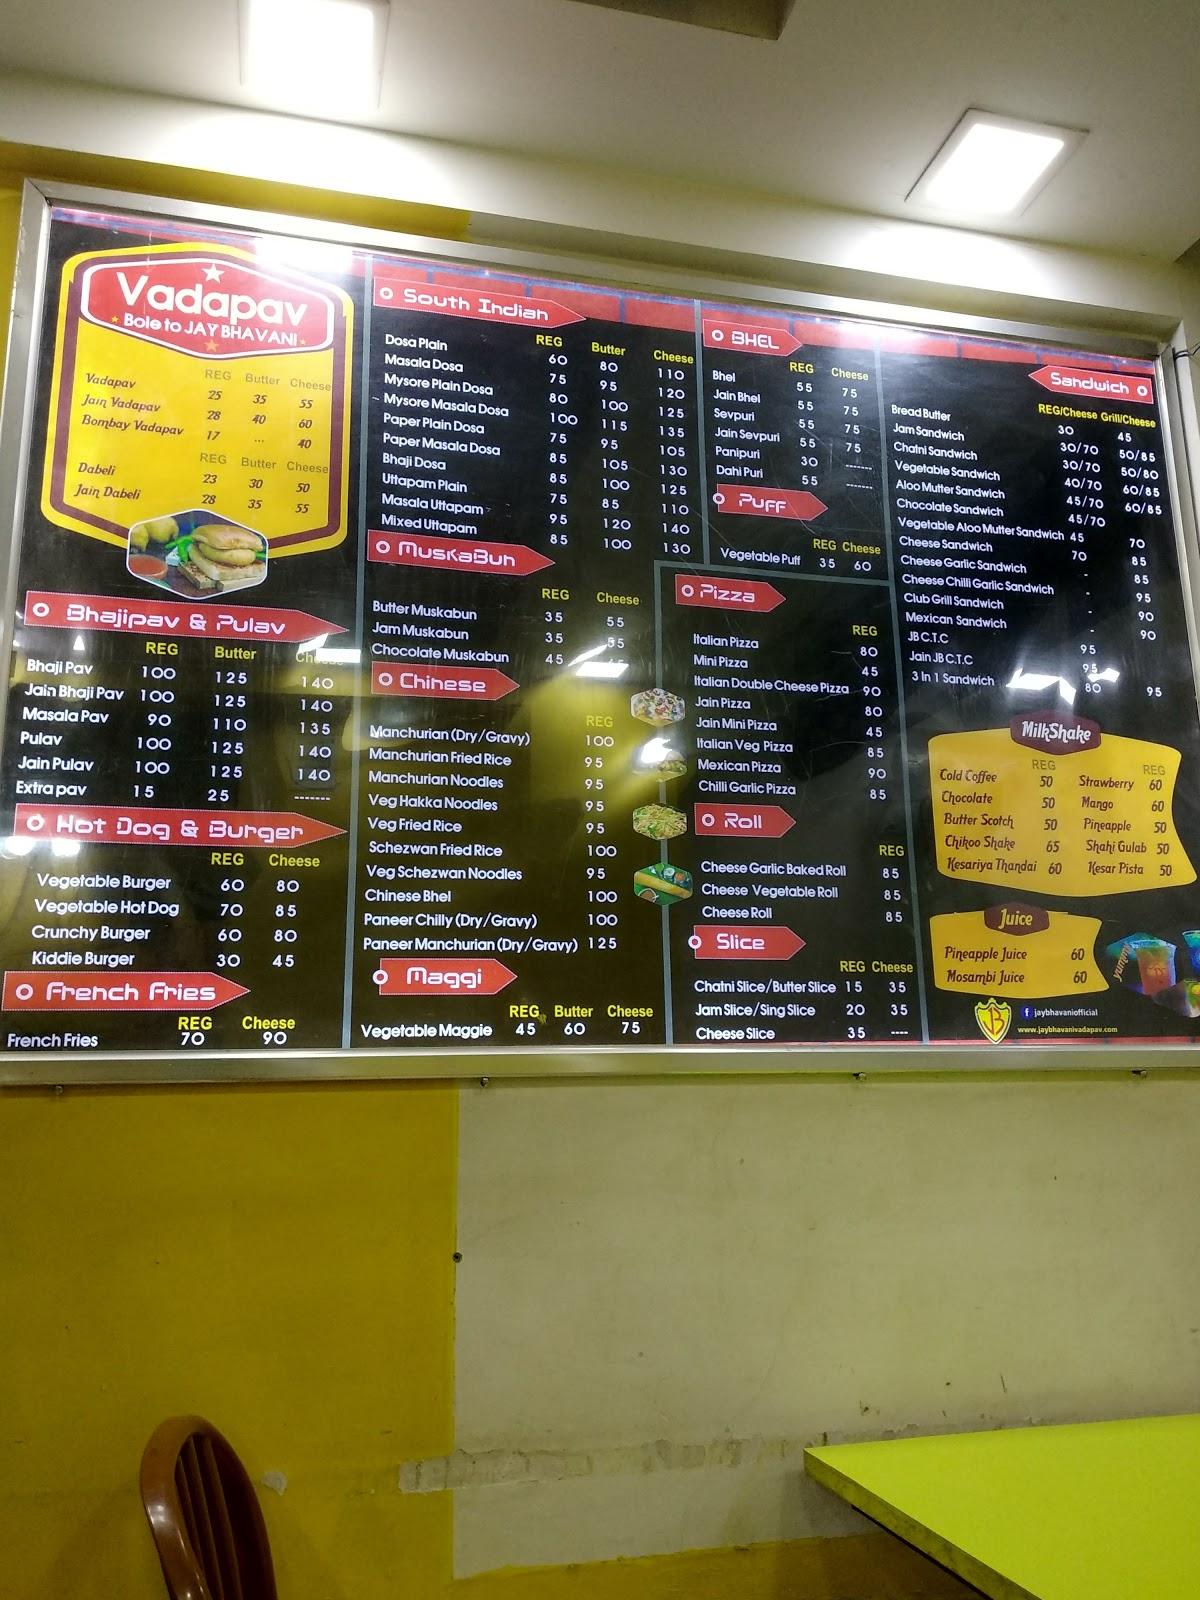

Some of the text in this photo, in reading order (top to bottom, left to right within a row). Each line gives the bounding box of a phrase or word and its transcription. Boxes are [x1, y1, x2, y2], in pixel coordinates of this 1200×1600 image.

[116, 271, 307, 328] Vadapav
[404, 288, 548, 321] South Indian
[124, 313, 298, 346] Bole to JAY BHAVANI
[385, 334, 447, 351] Dosa Plain
[536, 334, 562, 347] REG
[732, 331, 779, 349] BHEL
[592, 342, 626, 356] Butter
[654, 350, 694, 364] Cheese
[385, 353, 463, 372] Masala Dosa
[549, 354, 568, 365] 60
[86, 373, 136, 389] Vadapav
[205, 369, 231, 381] REG
[658, 368, 684, 380] 110
[713, 370, 735, 382] Bhel
[384, 373, 493, 395] Mysore Plain Dosa
[1050, 371, 1129, 394] Sandwich
[81, 394, 161, 412] Jain Vadapav
[208, 390, 222, 400] 25
[713, 389, 760, 403] Jain Bhel
[714, 408, 755, 422] Sevpuri
[891, 404, 951, 421] Bread Butter
[1038, 403, 1156, 428] REG/Cheese Grill/Cheese
[82, 414, 184, 436] Bombay Vadapav
[384, 412, 484, 434] Paper Plain Dosa
[1058, 425, 1074, 435] 30
[893, 423, 965, 441] Jam Sandwich
[715, 446, 760, 460] Panipuri
[1060, 442, 1099, 455] 30/70
[1119, 449, 1155, 462] 50/85
[78, 462, 116, 476] Dabeli
[801, 456, 818, 467] 30
[716, 465, 763, 478] Dahi Puri
[382, 472, 467, 492] Uttapam Plain
[896, 498, 1004, 516] Chocolate Sandwich
[382, 514, 477, 534] Mixed Uttapam
[898, 516, 1065, 540] Vegetable Aloo Mutter Sandwich
[550, 534, 568, 545] 85
[813, 538, 836, 550] REG
[664, 542, 691, 554] 130
[720, 547, 801, 565] Vegetable Puff
[854, 561, 871, 571] 60
[901, 574, 1054, 595] Cheese Chilli Garlic Sandwich
[700, 584, 755, 603] Pizza
[373, 600, 477, 620] Butter Muskabun
[1138, 611, 1154, 622] 90
[66, 603, 285, 634] Bhajipav & Pulav
[905, 612, 1007, 629] Mexican Sandwich
[146, 642, 178, 655] REG
[693, 633, 759, 649] Italian Pizza
[215, 646, 257, 659] Butter
[860, 646, 878, 657] 80
[27, 659, 93, 675] Bhaji Pav
[143, 666, 176, 679] 100
[216, 671, 247, 684] 125
[400, 673, 486, 692] Chinese
[23, 707, 109, 723] Masala Pav
[148, 714, 171, 726] 90
[369, 724, 530, 746] Manchurian (Dry/Gravy)
[586, 735, 614, 747] 100
[698, 758, 781, 773] Mexican Pizza
[939, 768, 997, 784] Cold Coffee
[1040, 775, 1053, 788] 50
[1079, 774, 1134, 791] Strawberry
[16, 780, 87, 798] Extra pav
[368, 794, 498, 811] Veg Hakka Noodles
[585, 801, 604, 812] 95
[1081, 796, 1113, 812] Mango
[724, 813, 762, 829] Roll
[1083, 817, 1131, 834] Pineapple
[57, 817, 303, 843] Hot Dog & Burger
[369, 841, 503, 856] Schezwan Fried Rice
[701, 861, 846, 876] Cheese Garlic Baked Roll
[947, 857, 1037, 874] Kesariya Thandai
[37, 873, 171, 891] Vegetable Burger
[221, 879, 244, 891] 60
[998, 908, 1033, 929] Juice
[32, 925, 151, 942] Crunchy Burger
[717, 933, 765, 949] Slice
[407, 967, 481, 989] Maggi
[947, 969, 1025, 986] Mosambi Juice
[46, 982, 216, 1001] French Fries
[808, 981, 836, 993] Slice
[846, 981, 862, 992] 15
[555, 1005, 593, 1017] Butter
[1034, 1008, 1098, 1018] jaybhavaniofficial
[242, 1016, 295, 1029] Cheese
[564, 1023, 585, 1035] 60
[1017, 1026, 1118, 1034] www.jaybhavanivadapav.com
[7, 1033, 98, 1047] French Fries
[263, 1031, 287, 1045] 90
[361, 1024, 492, 1040] Vegetable Maggie
